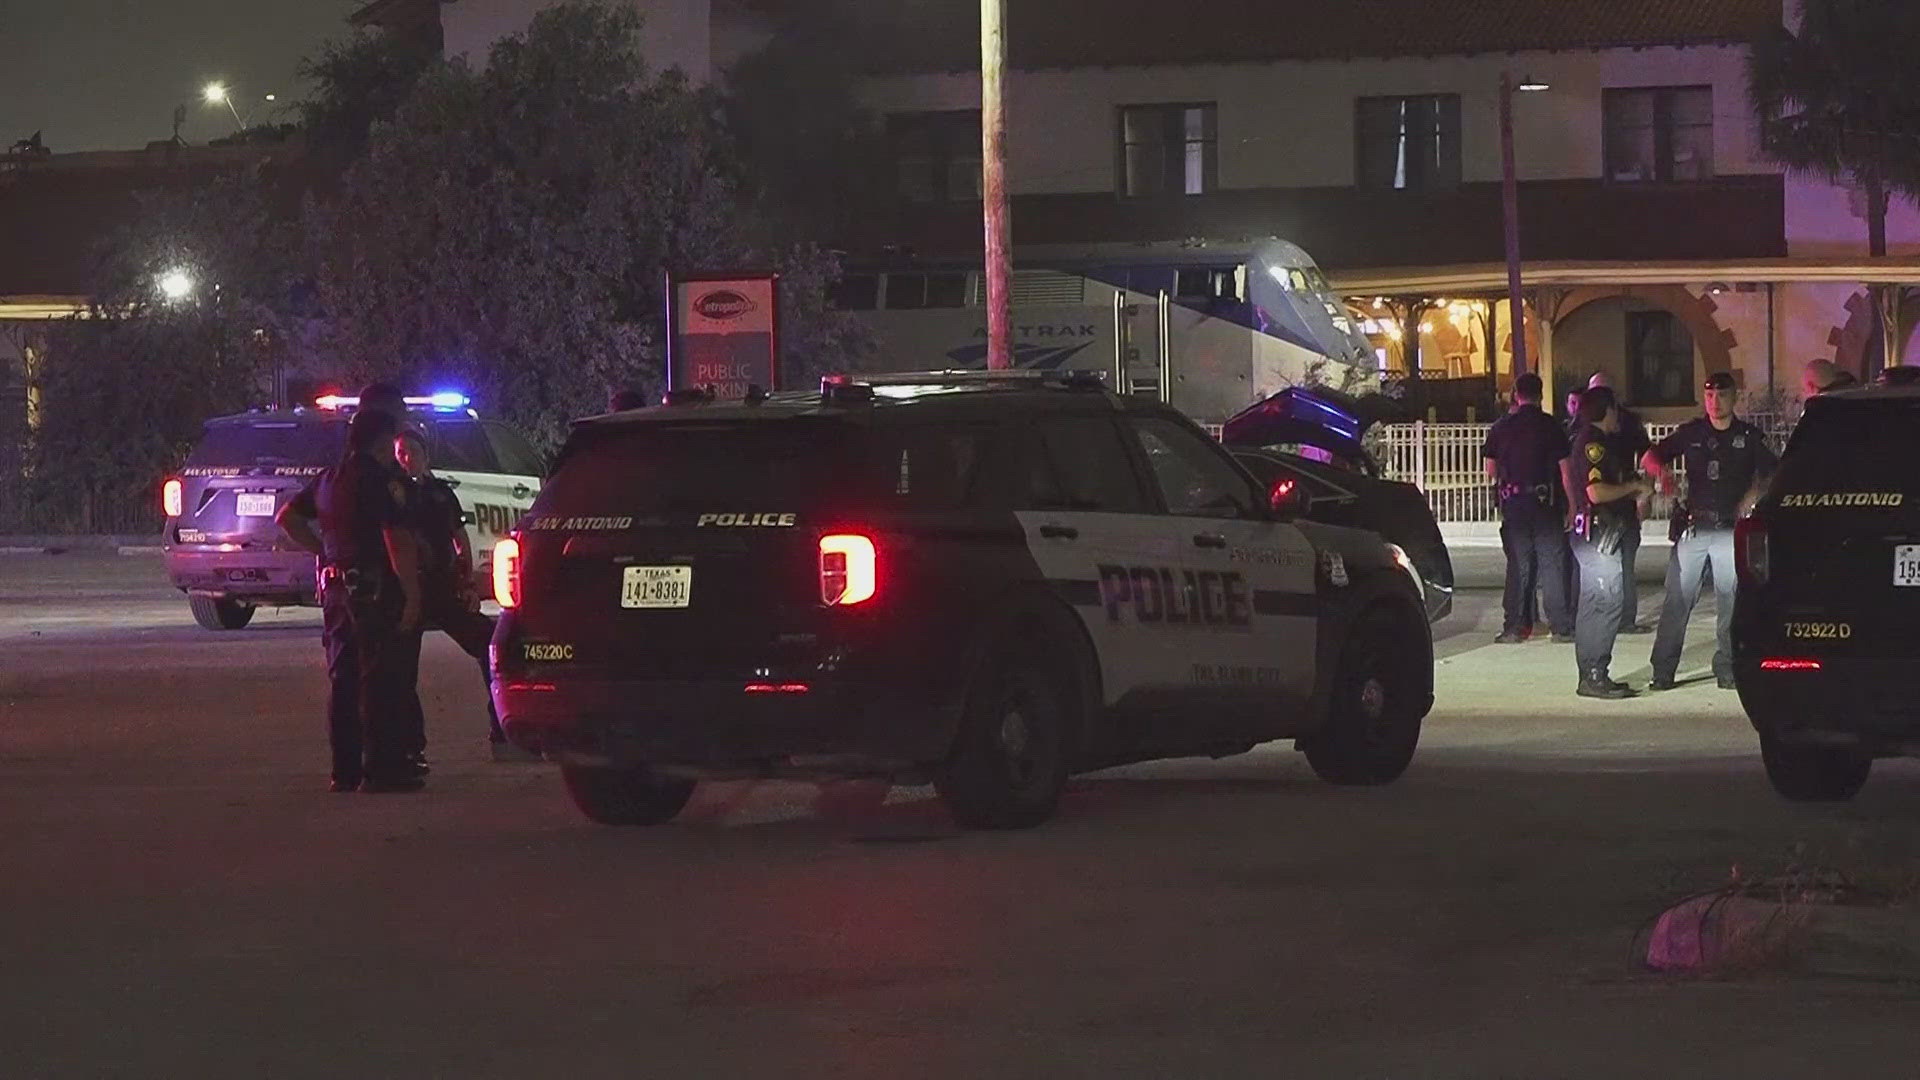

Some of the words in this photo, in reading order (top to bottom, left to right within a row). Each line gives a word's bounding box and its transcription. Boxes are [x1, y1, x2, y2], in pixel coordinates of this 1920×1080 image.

[972, 324, 1096, 337] ATRAK
[698, 363, 752, 380] PUBLIC
[1780, 493, 1814, 507] SAN
[1815, 492, 1903, 507] ANTONIO
[530, 516, 558, 530] SAN
[563, 516, 632, 530] ANTONIO
[697, 512, 797, 527] POLICE
[644, 569, 671, 578] TEXAS
[1097, 564, 1250, 626] POLICE
